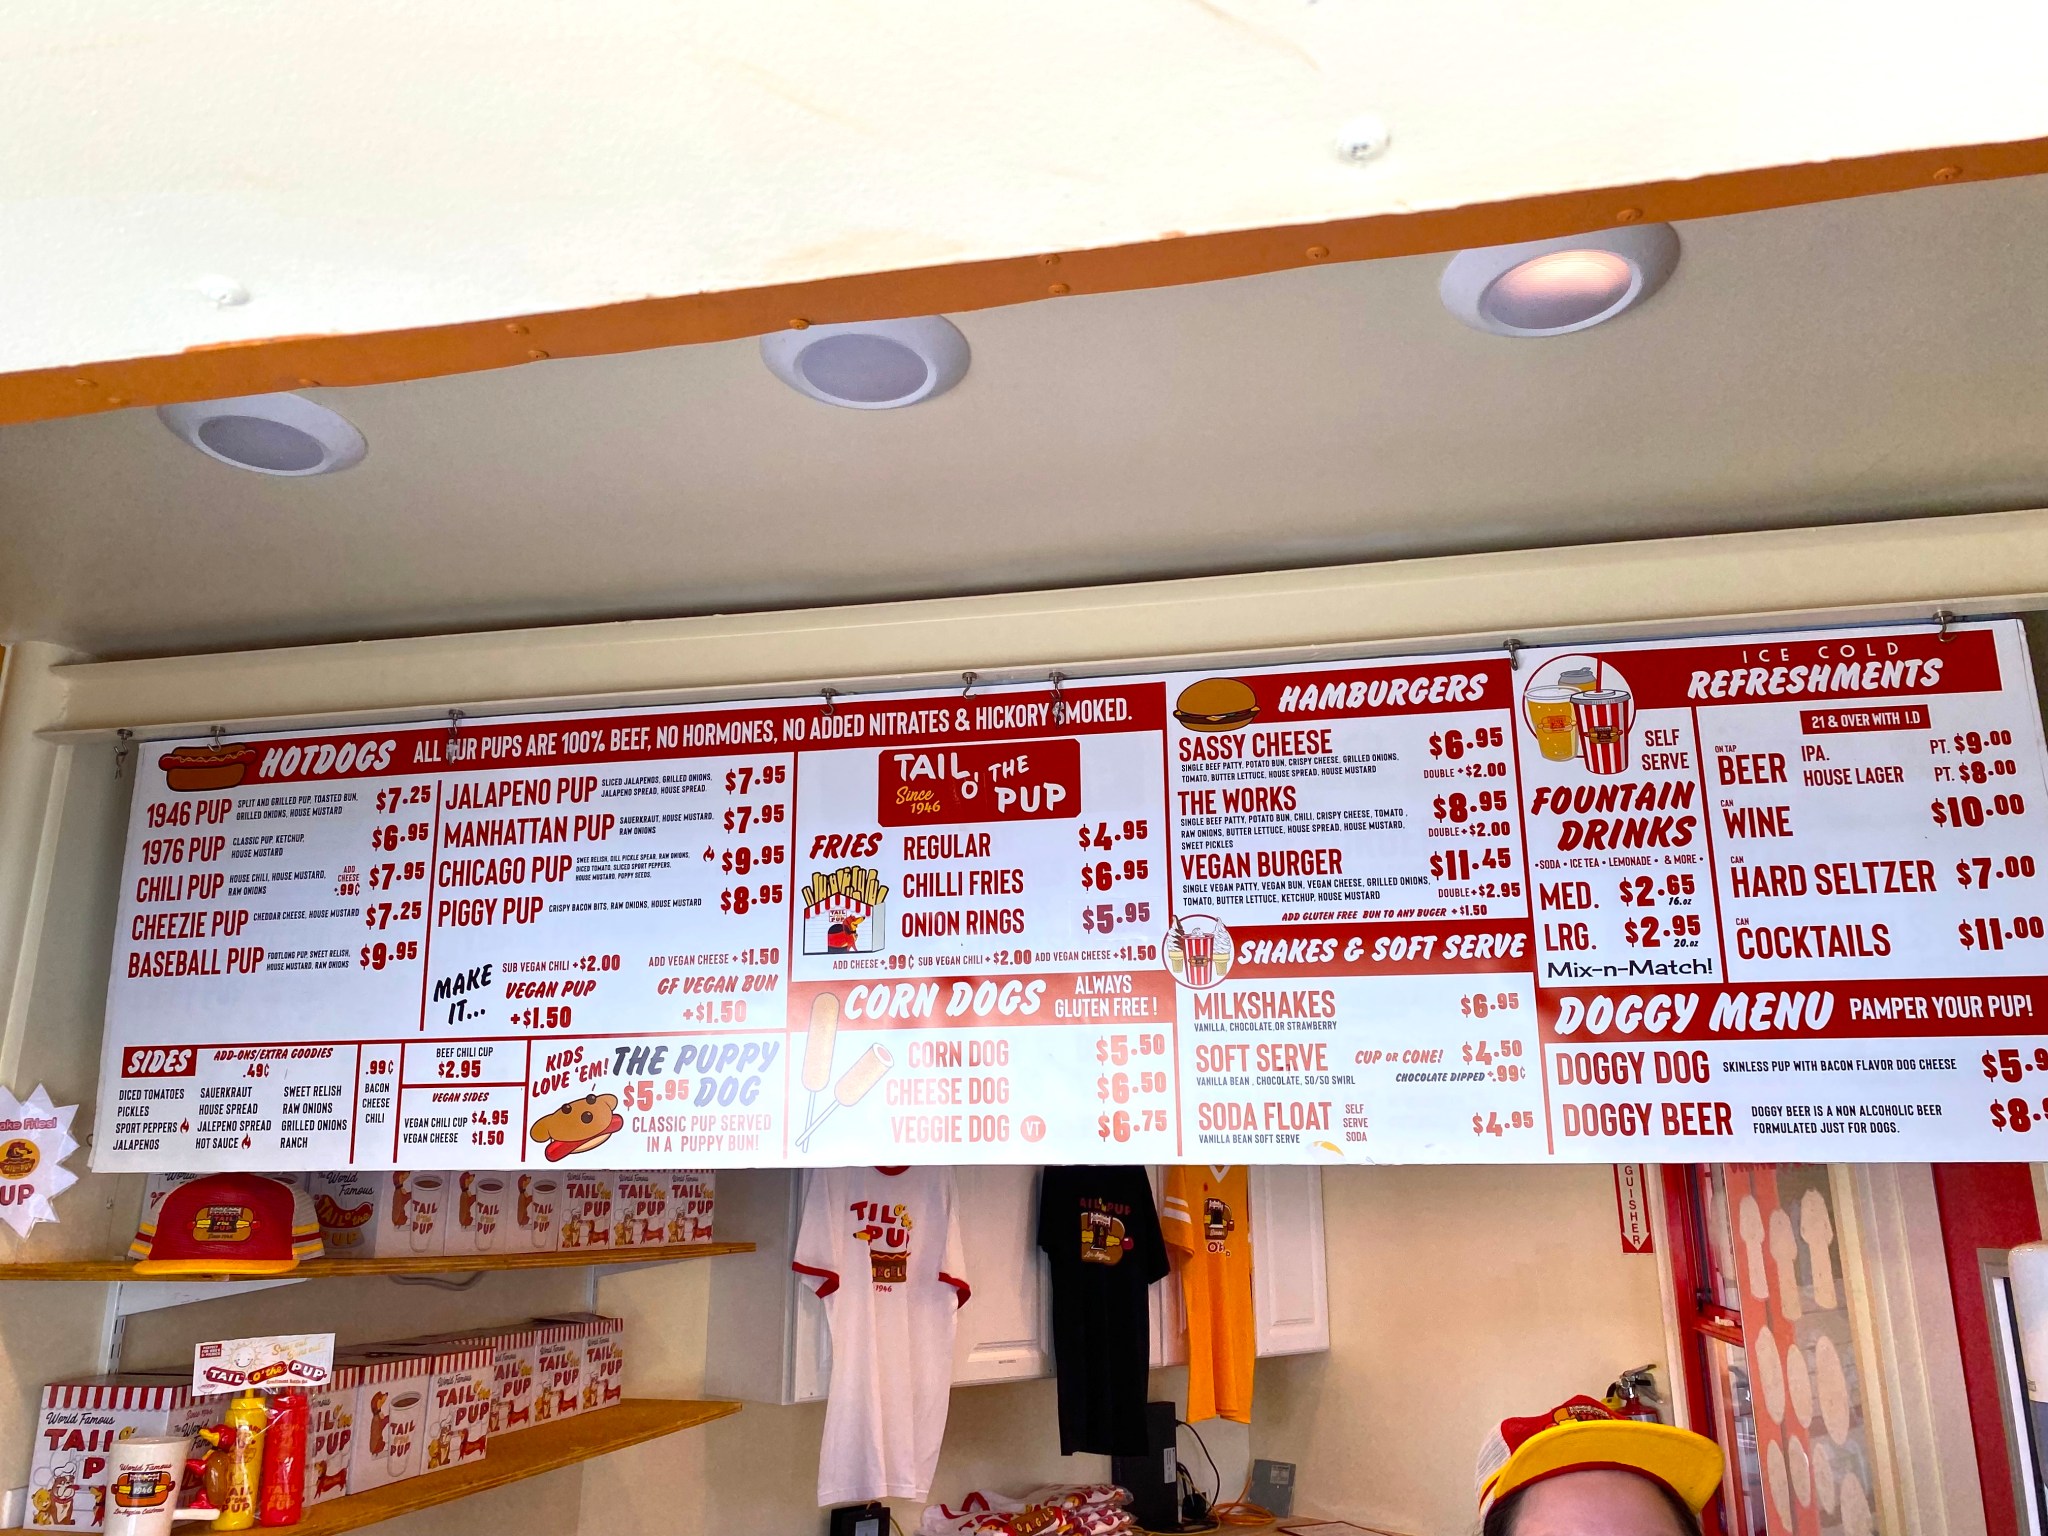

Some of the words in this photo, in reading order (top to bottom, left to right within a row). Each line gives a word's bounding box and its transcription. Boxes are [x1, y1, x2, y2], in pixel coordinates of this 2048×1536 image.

[1743, 648, 1789, 664] ICE
[1818, 642, 1898, 659] COLD
[1278, 673, 1488, 713] HAMBURGERS
[1687, 658, 1943, 699] REFRESHMENTS
[414, 740, 441, 763] ALL
[481, 735, 522, 759] PUPS
[526, 732, 557, 756] ARE
[562, 730, 606, 754] 100%
[610, 727, 651, 752] BEEF,
[657, 726, 678, 749] NO
[683, 720, 777, 747] HORMONES,
[783, 716, 804, 741] NO
[810, 712, 865, 740] ADDED
[870, 709, 949, 736] NITRATES
[955, 708, 970, 731] &
[976, 704, 1047, 729] HICKORY
[1179, 733, 1245, 762] SASSY
[1253, 729, 1332, 757] CHEESE
[1429, 727, 1503, 760] $6.95
[259, 740, 396, 778] HOTDOGS
[894, 752, 970, 782] TAIL
[988, 755, 1029, 783] THE
[1718, 753, 1787, 785] BEER
[725, 765, 785, 795] $7.95
[1803, 768, 1852, 786] HOUSE
[1856, 766, 1904, 785] LAGER
[376, 786, 431, 814] $7.25
[446, 778, 550, 810] JALAPENO
[557, 776, 597, 804] PUP
[896, 786, 934, 806] Since
[911, 800, 940, 814] 1946
[995, 782, 1066, 813] PUP
[1178, 791, 1216, 816] THE
[1223, 786, 1296, 812] WORKS
[1531, 781, 1695, 815] FOUNTAIN
[147, 803, 190, 828] 1946
[196, 799, 232, 824] PUP
[723, 804, 784, 834] $7.95
[1723, 806, 1793, 838] WINE
[1931, 794, 2024, 828] $10.00
[372, 823, 428, 851] $6.95
[444, 817, 567, 848] MANHATTAN
[573, 814, 614, 841] PUP
[809, 832, 883, 859] FRIES
[1079, 820, 1148, 851] $4.95
[1182, 841, 1204, 850] SWEET
[1206, 840, 1233, 849] PICKLES
[1558, 815, 1696, 851] DRINKS
[142, 840, 184, 864] 1976
[188, 836, 225, 862] PUP
[232, 850, 251, 858] HOUSE
[253, 848, 283, 858] MUSTARD
[904, 833, 990, 861] REGULAR
[338, 873, 359, 882] CHEESE
[344, 866, 355, 874] ADD
[369, 862, 424, 890] $7.95
[438, 857, 526, 887] CHICAGO
[532, 855, 572, 883] PUP
[1081, 859, 1149, 891] $6.95
[1181, 853, 1251, 880] VEGAN
[1258, 849, 1342, 876] BURGER
[1430, 848, 1511, 881] $11.45
[1731, 864, 1807, 898] HARD
[1815, 860, 1936, 895] SELTZER
[1956, 856, 2035, 889] $7.00
[136, 876, 181, 902] CHILI
[188, 873, 224, 900] PUP
[228, 887, 242, 896] RAW
[244, 886, 266, 895] ONIONS
[903, 871, 963, 898] CHILLI
[970, 869, 1023, 895] FRIES
[1539, 881, 1599, 910] MED.
[1619, 874, 1695, 907] $2.65
[438, 899, 497, 927] PIGGY
[503, 896, 543, 924] PUP
[720, 884, 782, 914] $8.95
[132, 912, 206, 940] CHEEZIE
[211, 910, 248, 936] PUP
[902, 911, 959, 938] ONION
[966, 908, 1024, 936] RINGS
[1545, 922, 1596, 951] LRG.
[1959, 916, 2044, 950] $11.00
[360, 942, 417, 970] $9.95
[1238, 939, 1338, 965] SHAKES
[1343, 938, 1365, 962] &
[1372, 935, 1438, 961] SOFT
[1442, 932, 1526, 959] SERVE
[1736, 924, 1891, 960] COCKTAILS
[128, 949, 221, 978] BASEBALL
[227, 947, 264, 974] PUP
[1548, 958, 1712, 978] Mix-n-Match!
[434, 963, 492, 1002] MAKE
[506, 981, 555, 1000] VEGAN
[561, 980, 596, 997] PUP
[1075, 975, 1132, 994] ALWAYS
[844, 983, 940, 1020] CORN
[946, 979, 1046, 1017] DOGS
[1194, 990, 1335, 1019] MILKSHAKES
[1461, 992, 1519, 1018] $6.95
[1553, 995, 1699, 1036] DOGGY
[1709, 991, 1834, 1033] MENU
[1850, 997, 1929, 1021] PAMPER
[1932, 996, 1983, 1019] YOUR
[1988, 995, 2033, 1017] PUP!
[127, 1049, 192, 1074] SIDES
[437, 1048, 455, 1058] BEEF
[457, 1047, 476, 1057] CHILI
[478, 1046, 493, 1056] CUP
[613, 1045, 668, 1076] THE
[673, 1041, 780, 1075] PUPPY
[1096, 1034, 1165, 1066] $5.50
[1196, 1045, 1250, 1072] SOFT
[1257, 1043, 1328, 1071] SERVE
[1462, 1040, 1522, 1066] $4.50
[438, 1061, 481, 1078] $2.95
[1555, 1052, 1647, 1085] DOGGY
[1655, 1050, 1709, 1084] DOG
[1723, 1060, 1769, 1073] SKINLESS
[1772, 1059, 1791, 1072] PUP
[1794, 1059, 1818, 1072] WITH
[119, 1089, 142, 1101] DICED
[144, 1088, 184, 1099] TOMATOES
[200, 1086, 252, 1098] SAUERKRAUT
[623, 1080, 689, 1111] $5.95
[694, 1076, 760, 1107] DOG
[886, 1078, 961, 1106] CHEESE
[969, 1077, 1009, 1105] DOG
[118, 1105, 149, 1117] PICKLES
[1098, 1109, 1167, 1142] $6.75
[1199, 1102, 1258, 1131] SODA
[1264, 1102, 1331, 1130] FLOAT
[1472, 1111, 1534, 1137] $4.95
[1563, 1103, 1653, 1137] DOGGY
[1662, 1102, 1733, 1136] BEER
[196, 1138, 211, 1150] HOT
[213, 1137, 238, 1149] SAUCE
[280, 1137, 307, 1149] RANCH
[892, 1116, 961, 1143] VEGGIE
[969, 1115, 1009, 1142] DOG
[567, 1184, 599, 1199] TAIL
[477, 1202, 500, 1215] TAIL
[584, 1201, 610, 1217] PUP
[477, 1223, 496, 1235] PUP
[210, 1370, 241, 1383] TAIL
[292, 1362, 324, 1378] PUP
[455, 1405, 489, 1426] PUP
